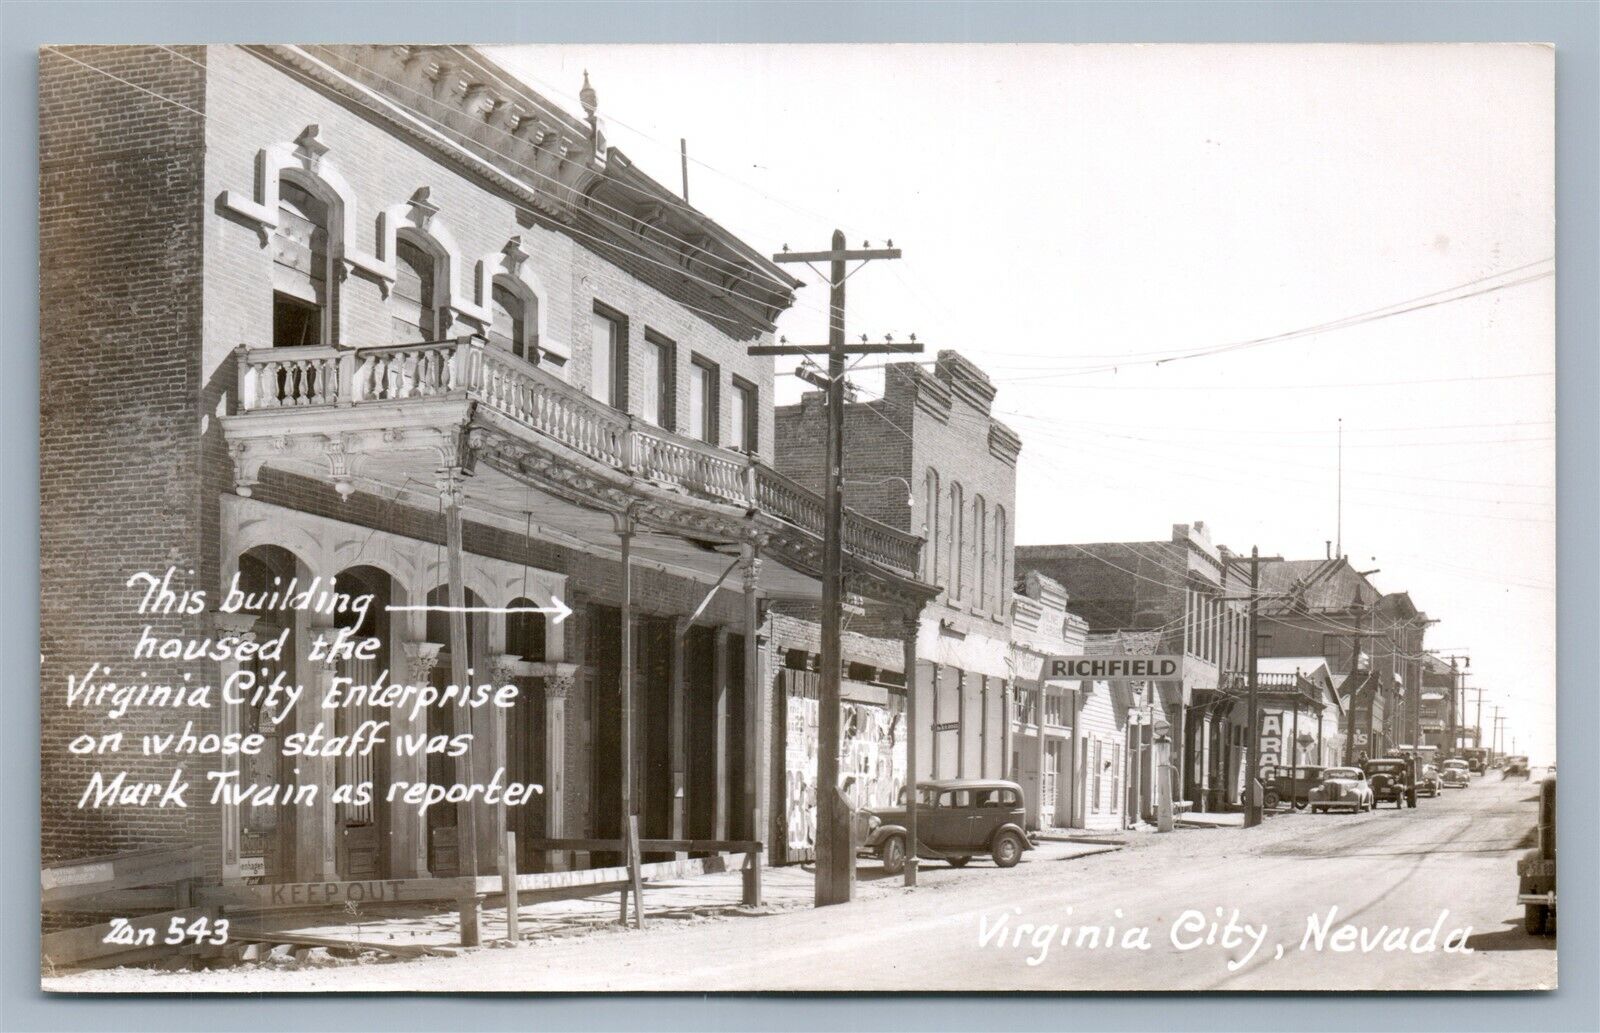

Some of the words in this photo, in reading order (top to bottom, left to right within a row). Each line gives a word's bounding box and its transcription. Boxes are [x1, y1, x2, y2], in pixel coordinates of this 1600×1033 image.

[1052, 660, 1177, 677] RICHFIELD
[271, 882, 339, 905] KEEP
[346, 880, 405, 901] OUT
